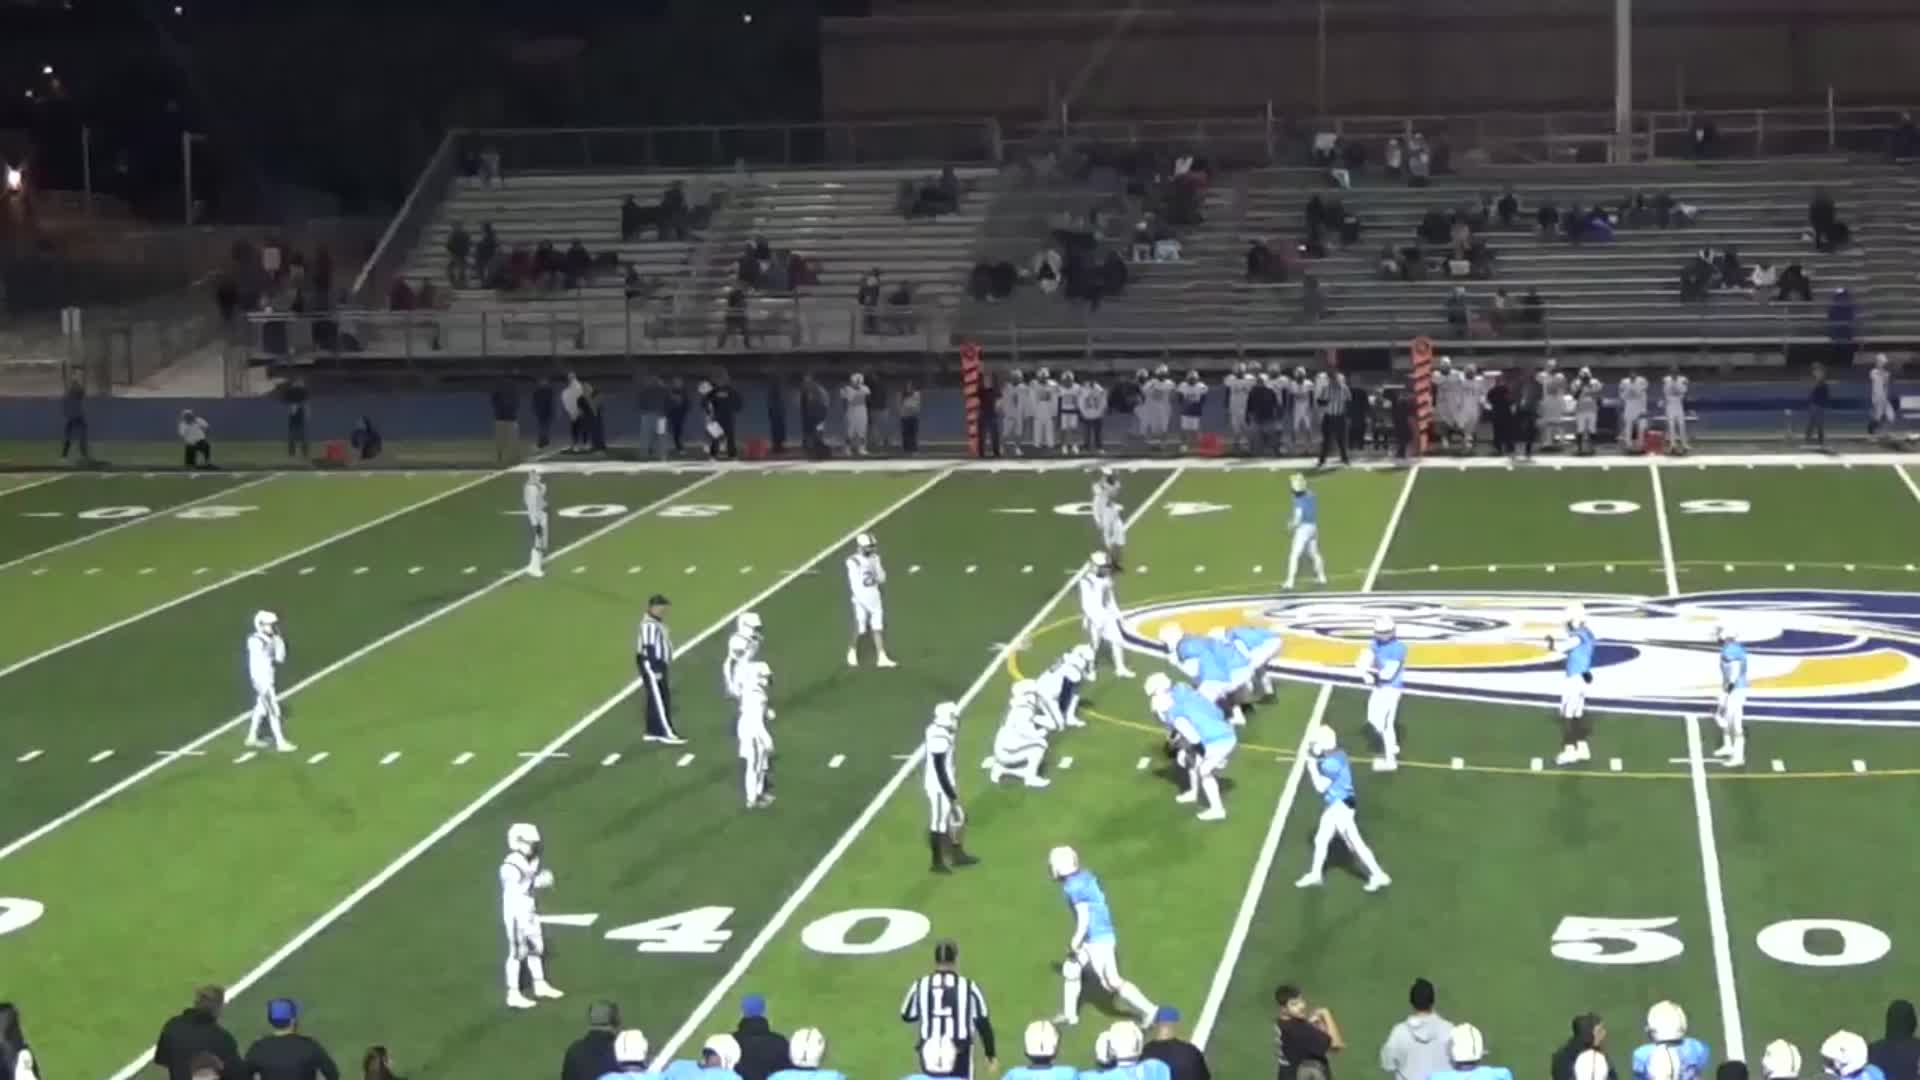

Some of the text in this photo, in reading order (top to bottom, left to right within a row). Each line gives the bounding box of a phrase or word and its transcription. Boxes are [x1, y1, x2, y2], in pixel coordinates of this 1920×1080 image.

[604, 904, 931, 956] 40
[1550, 916, 1892, 966] 50
[931, 987, 953, 1016] L
